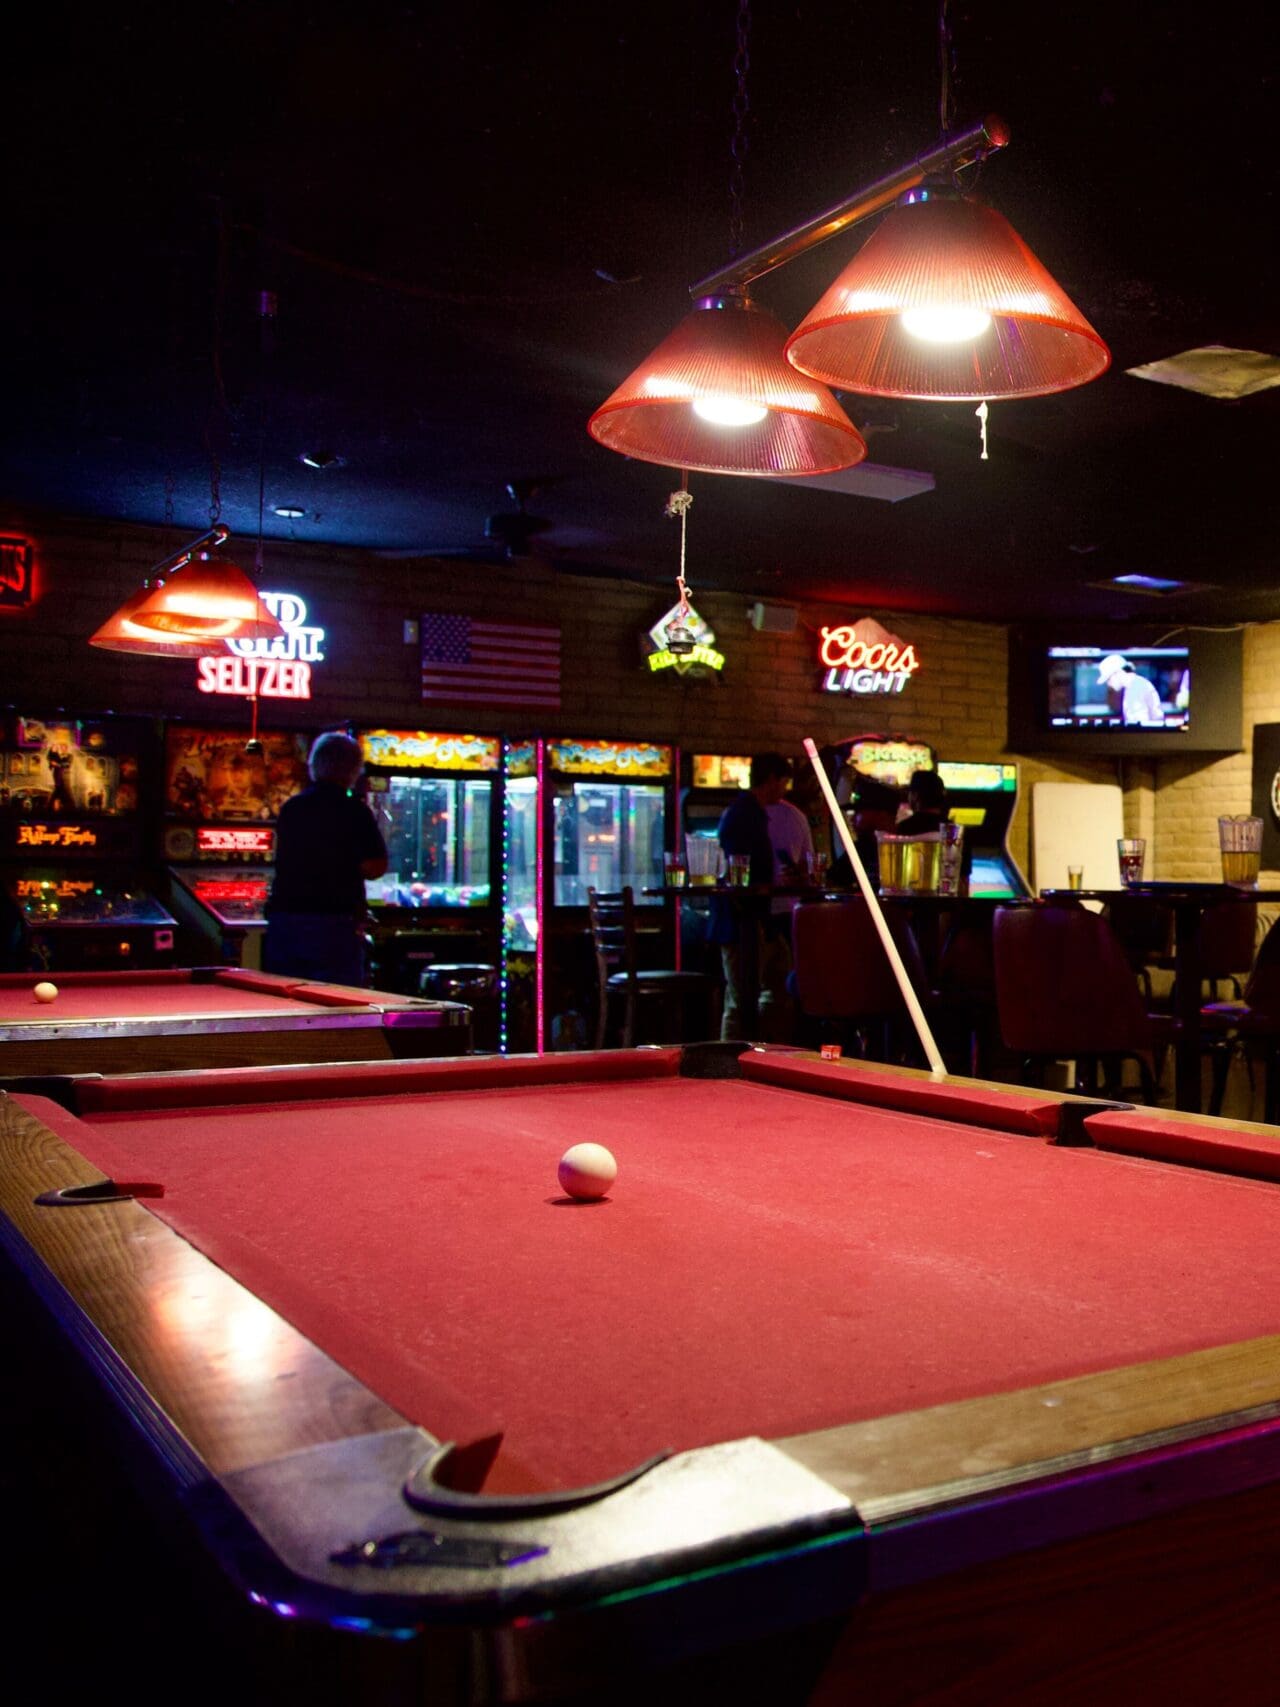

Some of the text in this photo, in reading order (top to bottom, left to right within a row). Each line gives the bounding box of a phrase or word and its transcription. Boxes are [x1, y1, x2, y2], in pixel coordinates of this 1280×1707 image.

[821, 626, 919, 673] Coors
[198, 656, 312, 699] SELTZER
[825, 668, 911, 693] LIGHT
